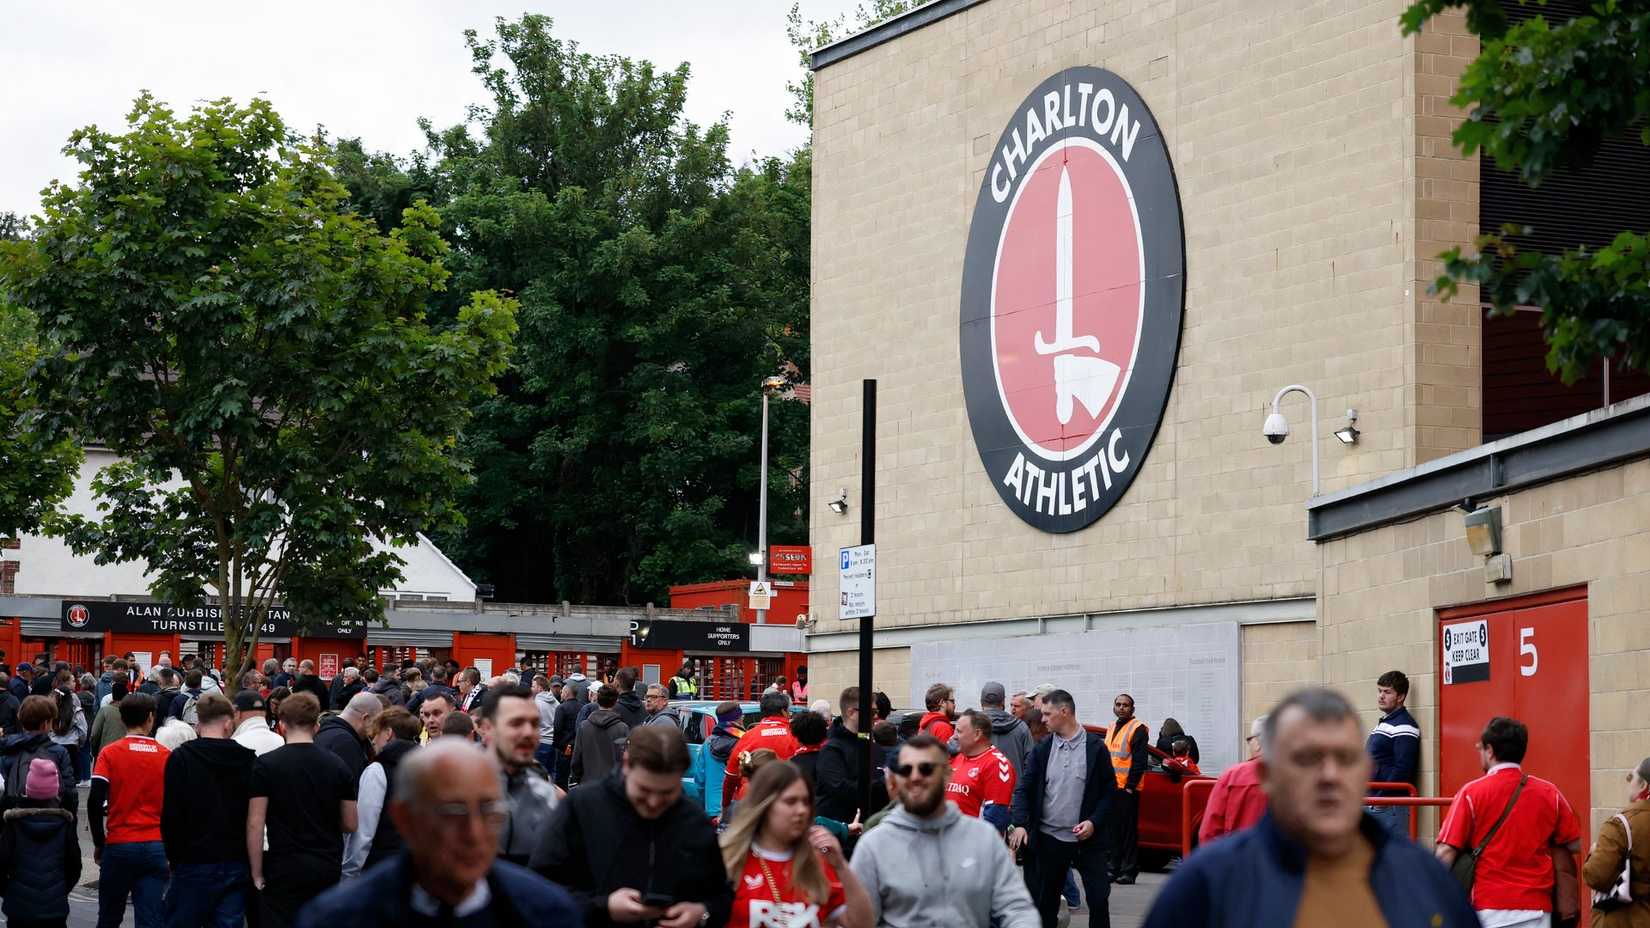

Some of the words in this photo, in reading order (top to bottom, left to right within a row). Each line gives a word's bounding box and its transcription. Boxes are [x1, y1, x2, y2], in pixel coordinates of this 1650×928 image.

[991, 83, 1140, 203] CHARLTON
[1003, 428, 1130, 516] ATHLETIC
[127, 606, 161, 616] ALAN
[152, 620, 228, 632] TURNSTILE
[1453, 633, 1464, 645] EXIT
[1465, 631, 1477, 643] GATE
[1452, 650, 1464, 662] KEEP
[1465, 648, 1480, 661] CLEAR
[1520, 627, 1538, 677] 5
